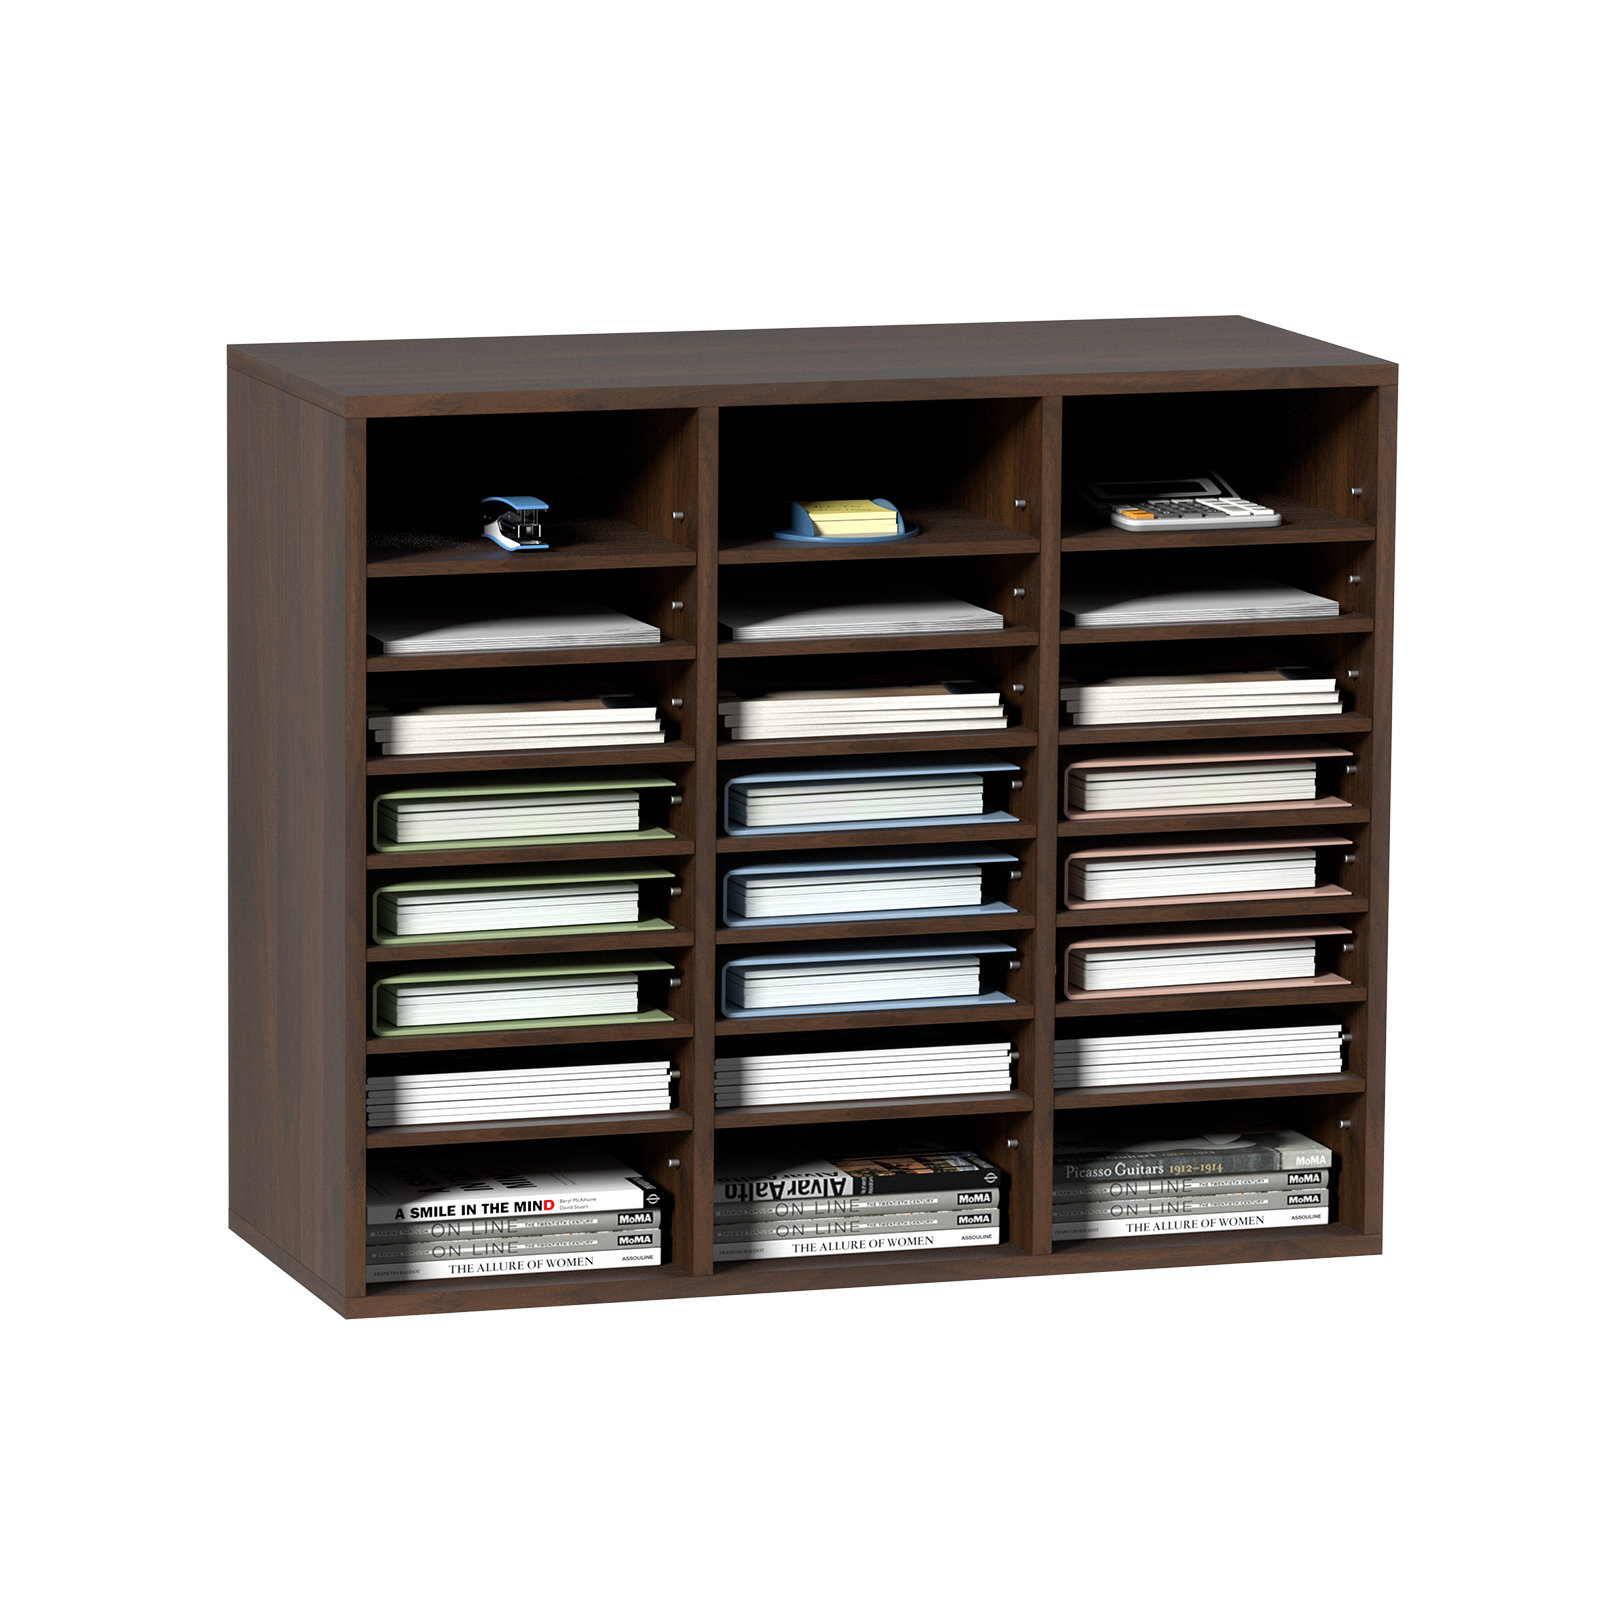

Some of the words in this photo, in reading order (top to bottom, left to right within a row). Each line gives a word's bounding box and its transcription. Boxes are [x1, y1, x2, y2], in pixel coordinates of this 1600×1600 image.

[1295, 1155, 1326, 1166] MoMA
[1065, 1165, 1112, 1179] Picasso
[1115, 1162, 1164, 1176] Guitars
[1169, 1161, 1223, 1176] 1912–1914
[1289, 1173, 1320, 1184] MoMA
[1109, 1182, 1137, 1197] ON
[1148, 1178, 1192, 1195] LINE
[959, 1193, 991, 1204] MoMA
[1289, 1195, 1319, 1204] MoMA
[394, 1208, 405, 1220] A
[410, 1205, 456, 1219] SMILE
[461, 1204, 476, 1216] IN
[482, 1202, 509, 1214] THE
[514, 1199, 555, 1213] MIND
[775, 1202, 803, 1217] ON
[815, 1198, 860, 1215] LINE
[1110, 1204, 1138, 1217] ON
[1149, 1200, 1192, 1214] LINE
[619, 1213, 652, 1224] MoMA
[958, 1215, 990, 1224] MoMA
[1126, 1222, 1150, 1233] THE
[1153, 1219, 1198, 1231] ALLURE
[1200, 1218, 1217, 1228] OF
[1219, 1215, 1265, 1227] WOMEN
[431, 1222, 460, 1238] ON
[472, 1218, 518, 1236] LINE
[776, 1224, 804, 1237] ON
[815, 1220, 860, 1235] LINE
[619, 1235, 651, 1245] MoMA
[792, 1242, 816, 1253] THE
[819, 1240, 866, 1252] ALLURE
[868, 1238, 885, 1249] OF
[888, 1235, 934, 1247] WOMEN
[432, 1245, 461, 1258] ON
[473, 1241, 518, 1256] LINE
[448, 1264, 473, 1274] THE
[476, 1261, 524, 1273] ALLURE
[527, 1260, 543, 1269] OF
[546, 1256, 594, 1268] WOMEN
